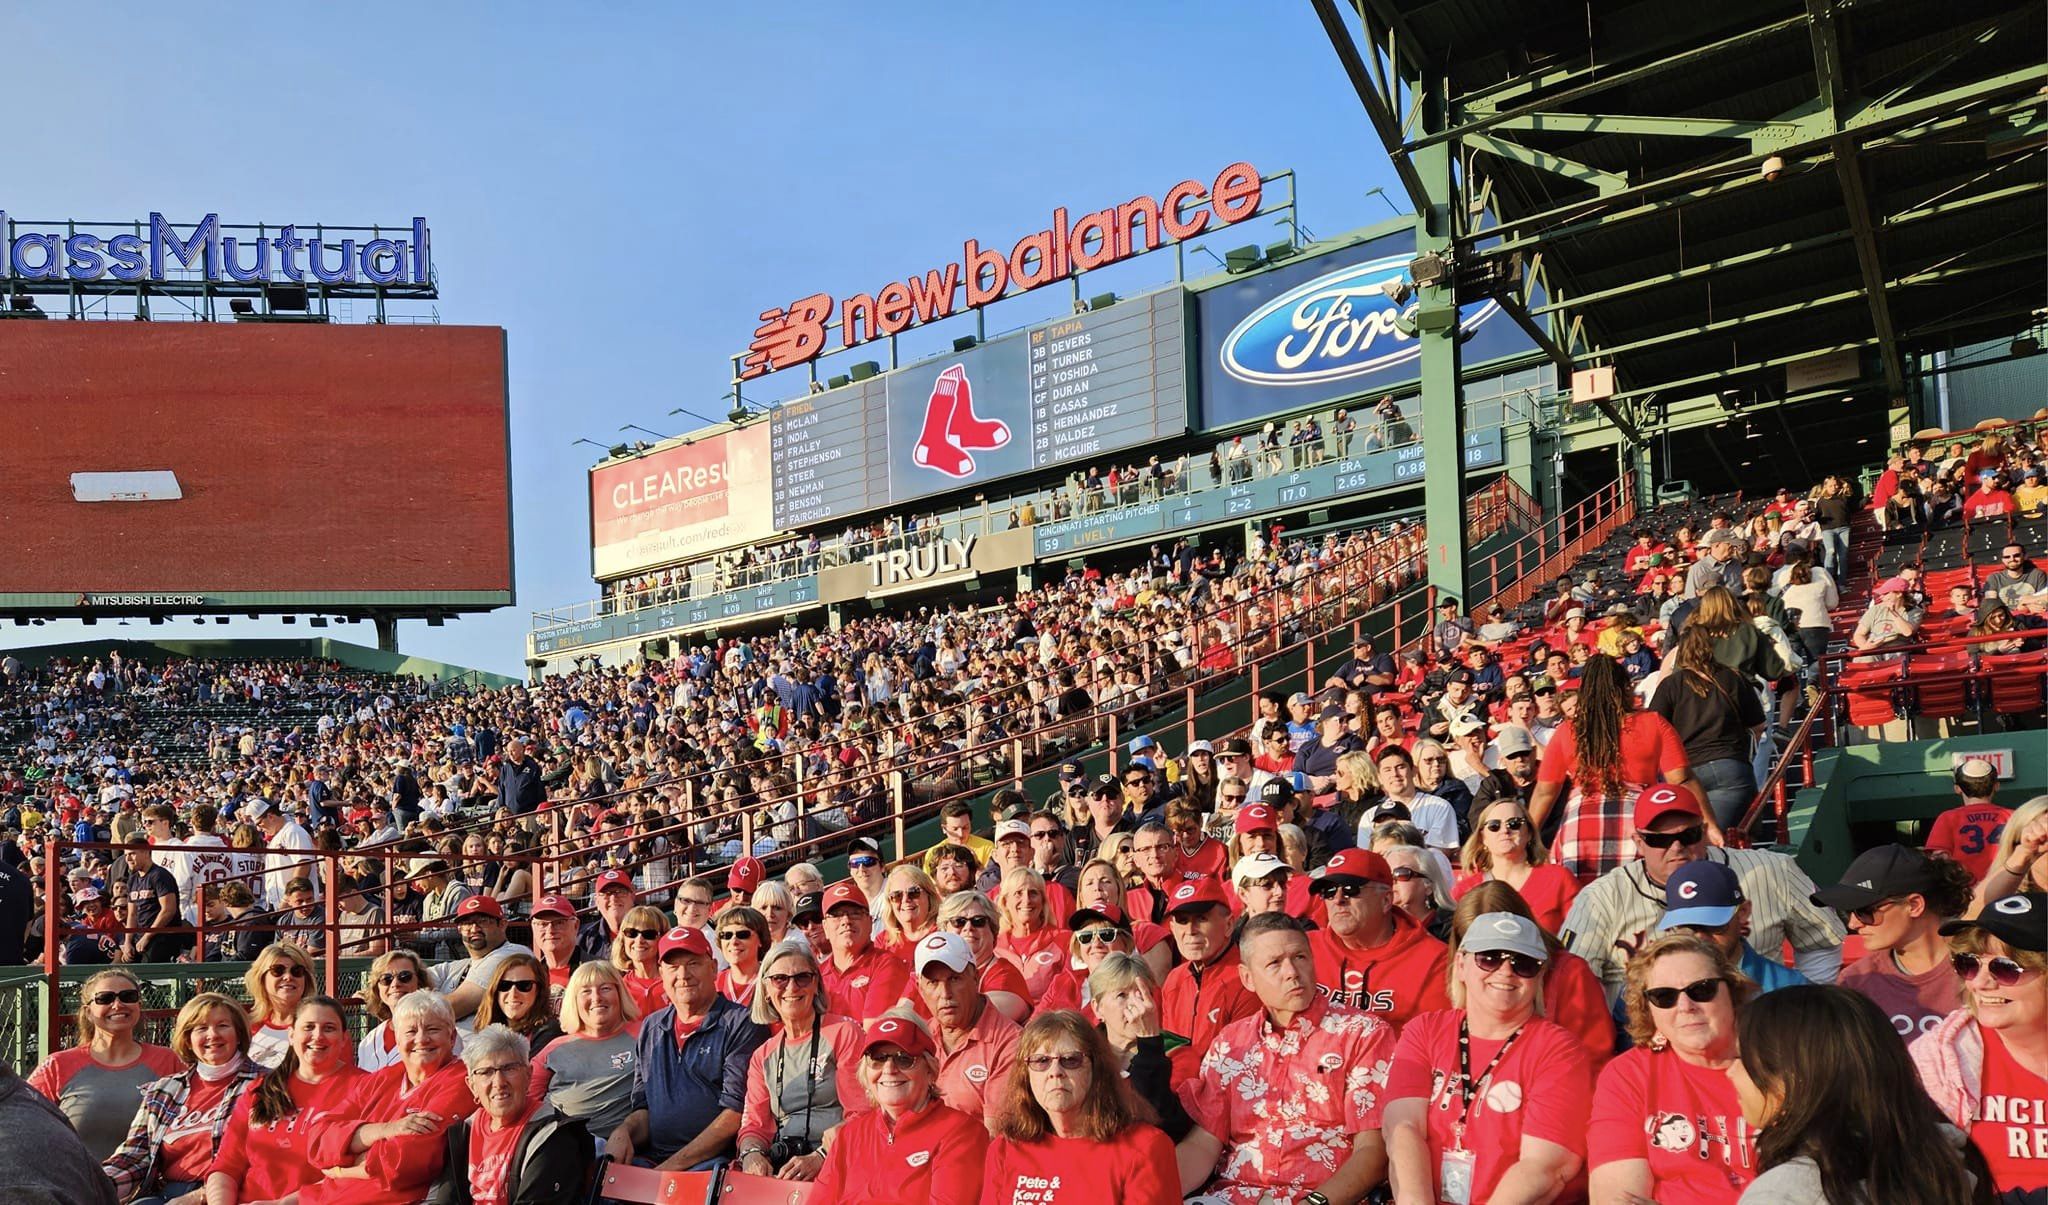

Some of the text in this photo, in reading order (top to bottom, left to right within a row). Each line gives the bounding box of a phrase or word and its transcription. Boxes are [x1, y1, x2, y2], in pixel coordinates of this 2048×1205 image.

[1032, 321, 1083, 344] RF TAPIA
[1033, 333, 1092, 359] 3B DEVERS
[1033, 349, 1092, 374] DH TURNER
[1034, 363, 1098, 389] LF YOSHIDA
[1590, 374, 1595, 394] 1
[1035, 380, 1089, 404] CF DURAN
[787, 402, 814, 417] FRIEDL
[1036, 396, 1088, 419] 1B CASAS
[773, 413, 818, 434] SS MCLAIN
[1036, 404, 1117, 434] SS HERNANDEZ
[773, 430, 809, 448] 2B INDIA
[1036, 425, 1095, 449] 2B VALDEZ
[1471, 434, 1479, 445] K
[773, 440, 820, 461] DH FRALEY
[1040, 440, 1100, 464] C MCGUIRE
[1398, 446, 1424, 461] WHIP
[1469, 449, 1482, 463] 18
[776, 448, 842, 473] C STEPHENSON
[1340, 460, 1362, 473] ERA
[788, 469, 814, 484] STEER
[1398, 461, 1426, 477] 0.88
[612, 459, 734, 509] CLEAResu
[1290, 474, 1300, 485] IP
[1338, 473, 1366, 490] 2.65
[775, 480, 824, 501] 3B NEWMAN
[1230, 485, 1250, 497] W-L
[1283, 487, 1306, 501] 17.0
[775, 495, 822, 514] LF BENSON
[1184, 497, 1191, 506] G
[1230, 498, 1251, 513] 2-2
[775, 506, 831, 528] RF FAIRCHILD
[1040, 504, 1160, 536] CINCINNATI STARTING PITCHER
[1184, 511, 1191, 521] 4
[1044, 527, 1115, 551] 59 LIVELY
[865, 534, 977, 586] TRULY
[92, 595, 204, 606] MITSUBISHI ELECTRIC
[725, 594, 738, 603] ERA
[758, 597, 773, 608] 1.44
[796, 591, 806, 600] 37
[581, 621, 602, 631] PITCHER
[662, 617, 674, 627] 3-2
[540, 634, 583, 651] 66 BELLO
[1263, 784, 1280, 796] CIN
[1678, 881, 1698, 899] C
[668, 927, 689, 940] C
[926, 936, 947, 950] C
[1017, 1175, 1060, 1189] Pete &
[1013, 1189, 1054, 1201] Ken &
